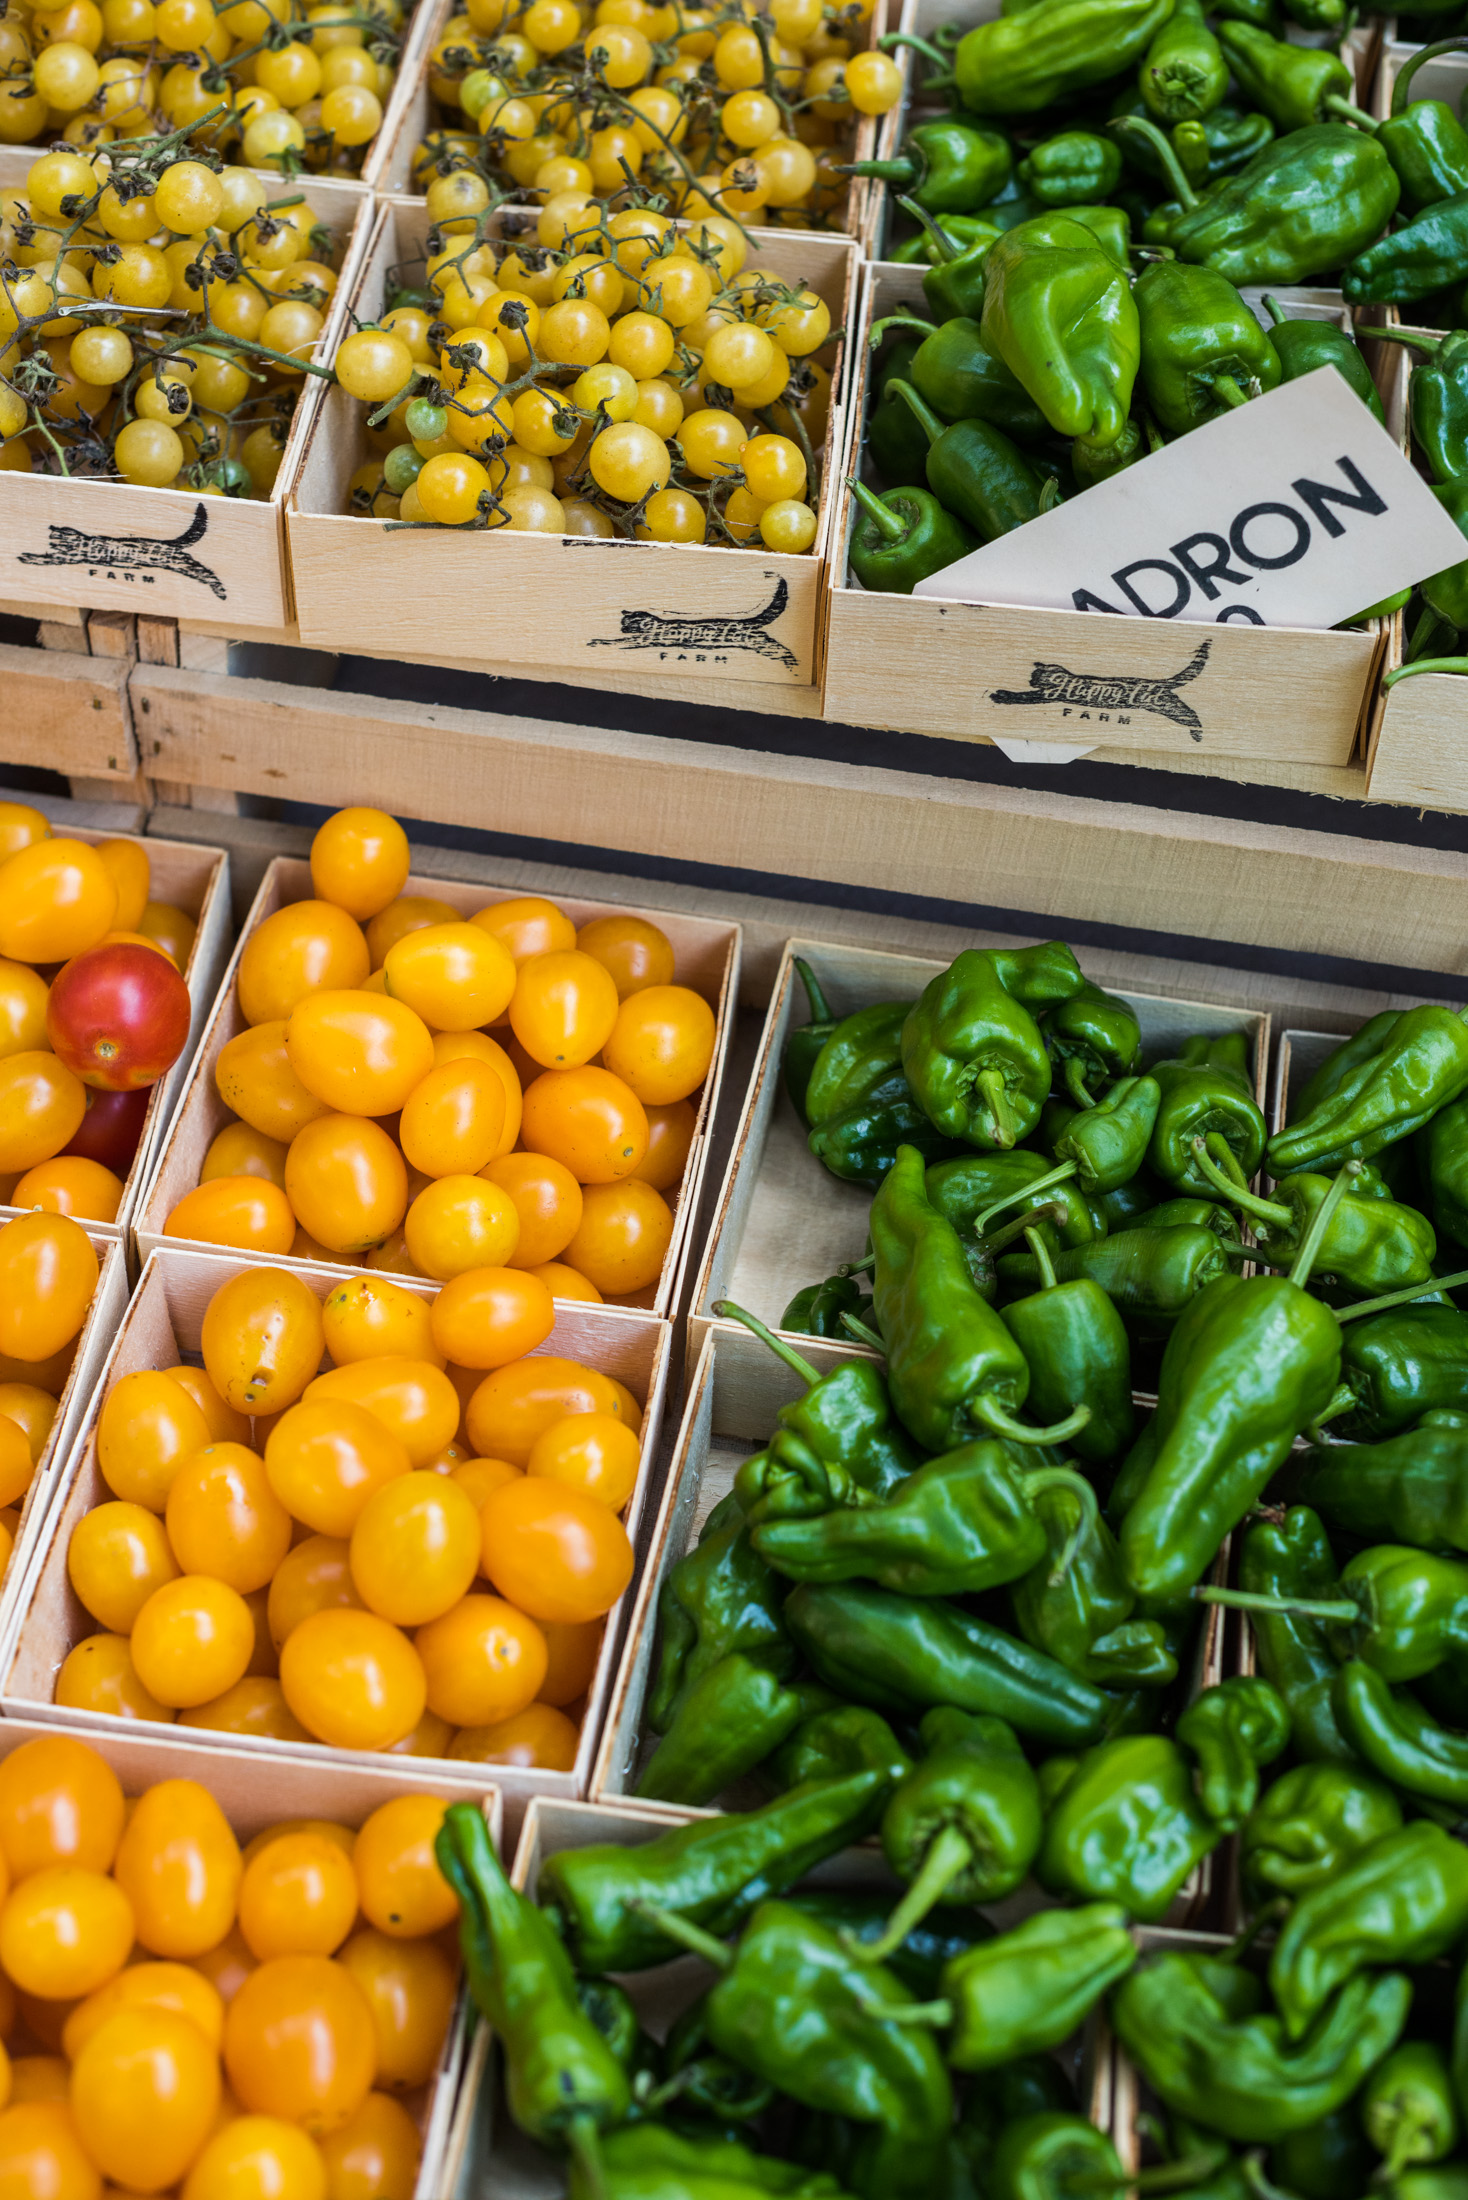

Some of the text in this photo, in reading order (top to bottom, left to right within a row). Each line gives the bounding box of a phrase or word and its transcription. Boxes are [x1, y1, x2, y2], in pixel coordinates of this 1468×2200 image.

[89, 569, 155, 584] FARM
[659, 652, 728, 664] FARM
[1044, 673, 1127, 704] Happy
[1062, 707, 1131, 725] FARM
